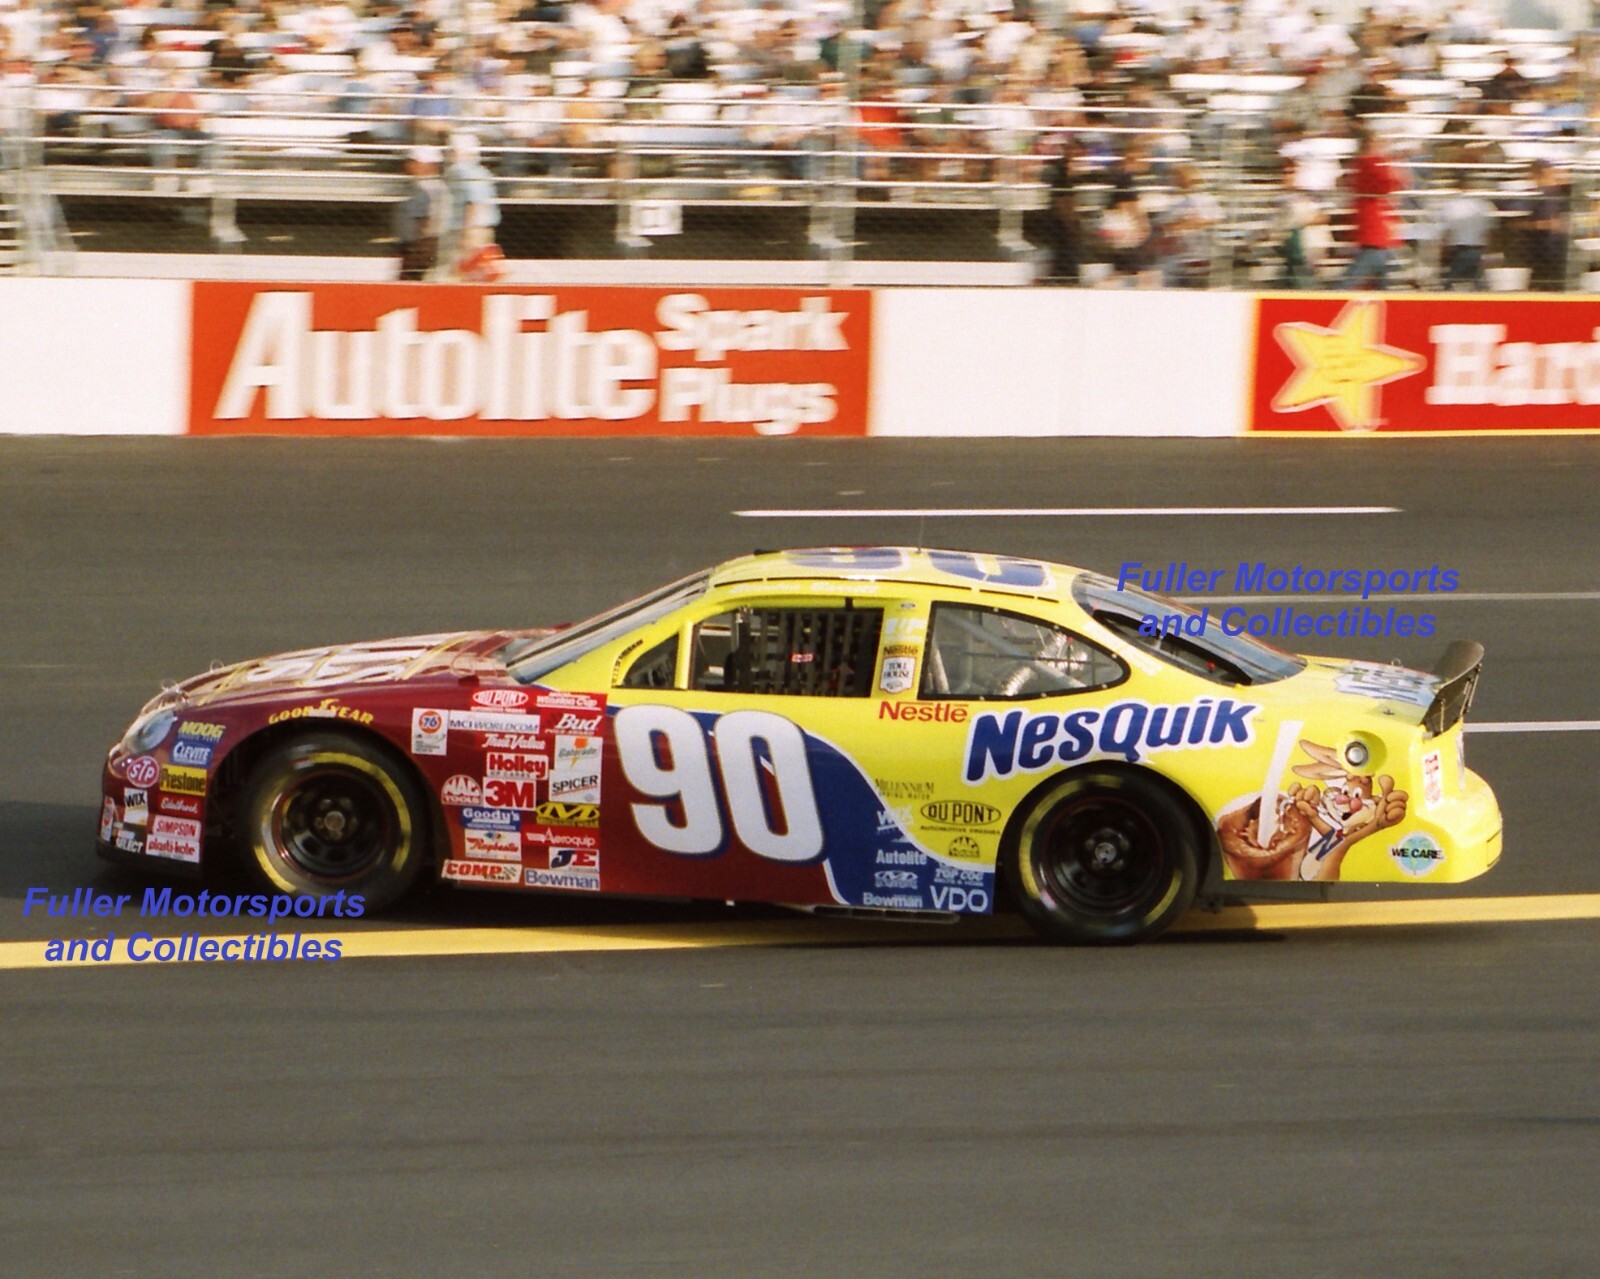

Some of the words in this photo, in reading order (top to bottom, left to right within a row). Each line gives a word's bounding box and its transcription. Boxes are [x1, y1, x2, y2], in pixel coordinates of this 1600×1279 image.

[655, 293, 849, 362] Spark
[213, 291, 657, 420] Autolite
[659, 367, 836, 435] Plugs
[178, 721, 226, 739] MOOG
[424, 717, 438, 727] 76
[555, 713, 602, 731] Bud
[130, 760, 155, 781] STP
[489, 755, 546, 778] Holley
[161, 769, 205, 792] Prestone
[552, 775, 598, 792] SPICER
[614, 704, 824, 862] 90
[125, 794, 146, 807] WIX
[485, 781, 535, 808] 3M
[463, 808, 520, 821] Goody's
[156, 821, 196, 836] SIMPSON
[544, 827, 595, 848] Aeroquip
[551, 850, 597, 868] JE
[876, 849, 928, 866] Autolite
[1391, 848, 1409, 858] WE
[446, 863, 502, 876] COMP
[525, 869, 599, 889] Bowman
[863, 892, 923, 908] Bowman
[930, 885, 988, 912] VDO
